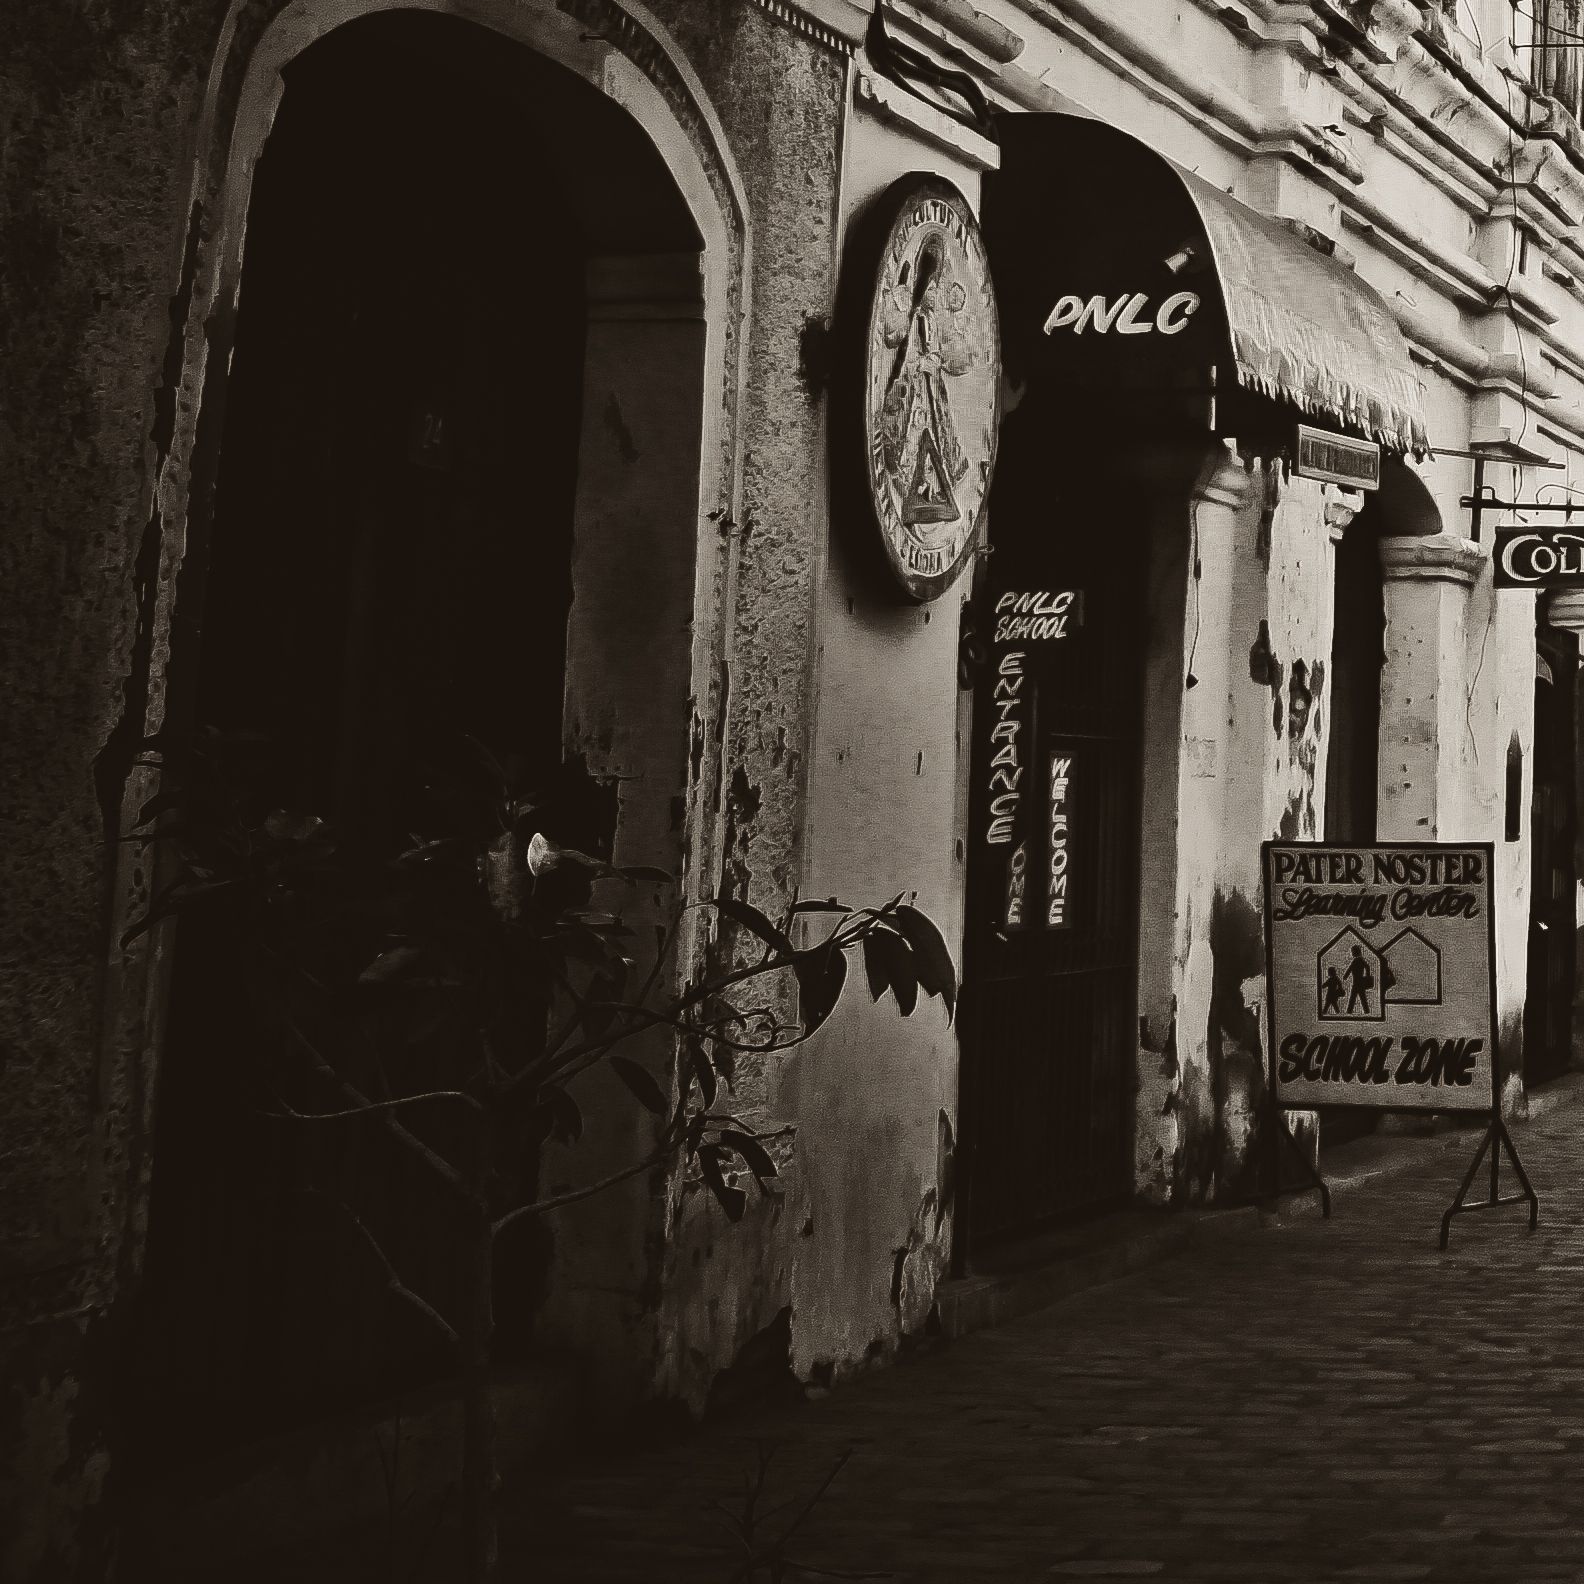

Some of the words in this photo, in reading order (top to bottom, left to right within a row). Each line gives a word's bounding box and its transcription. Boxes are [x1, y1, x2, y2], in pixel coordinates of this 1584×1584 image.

[1043, 291, 1201, 335] PNLC
[995, 591, 1075, 615] PNLC
[994, 615, 1068, 643] SCHOOL
[986, 651, 1027, 844] ENTRANCE
[1049, 757, 1072, 924] WELCOME
[1273, 853, 1365, 885] PATER
[1372, 853, 1485, 885] NOSTER
[1274, 887, 1389, 930] Learning
[1390, 887, 1481, 920] Center
[1278, 1033, 1394, 1084] SCHOOL
[1394, 1035, 1484, 1087] ZONE
